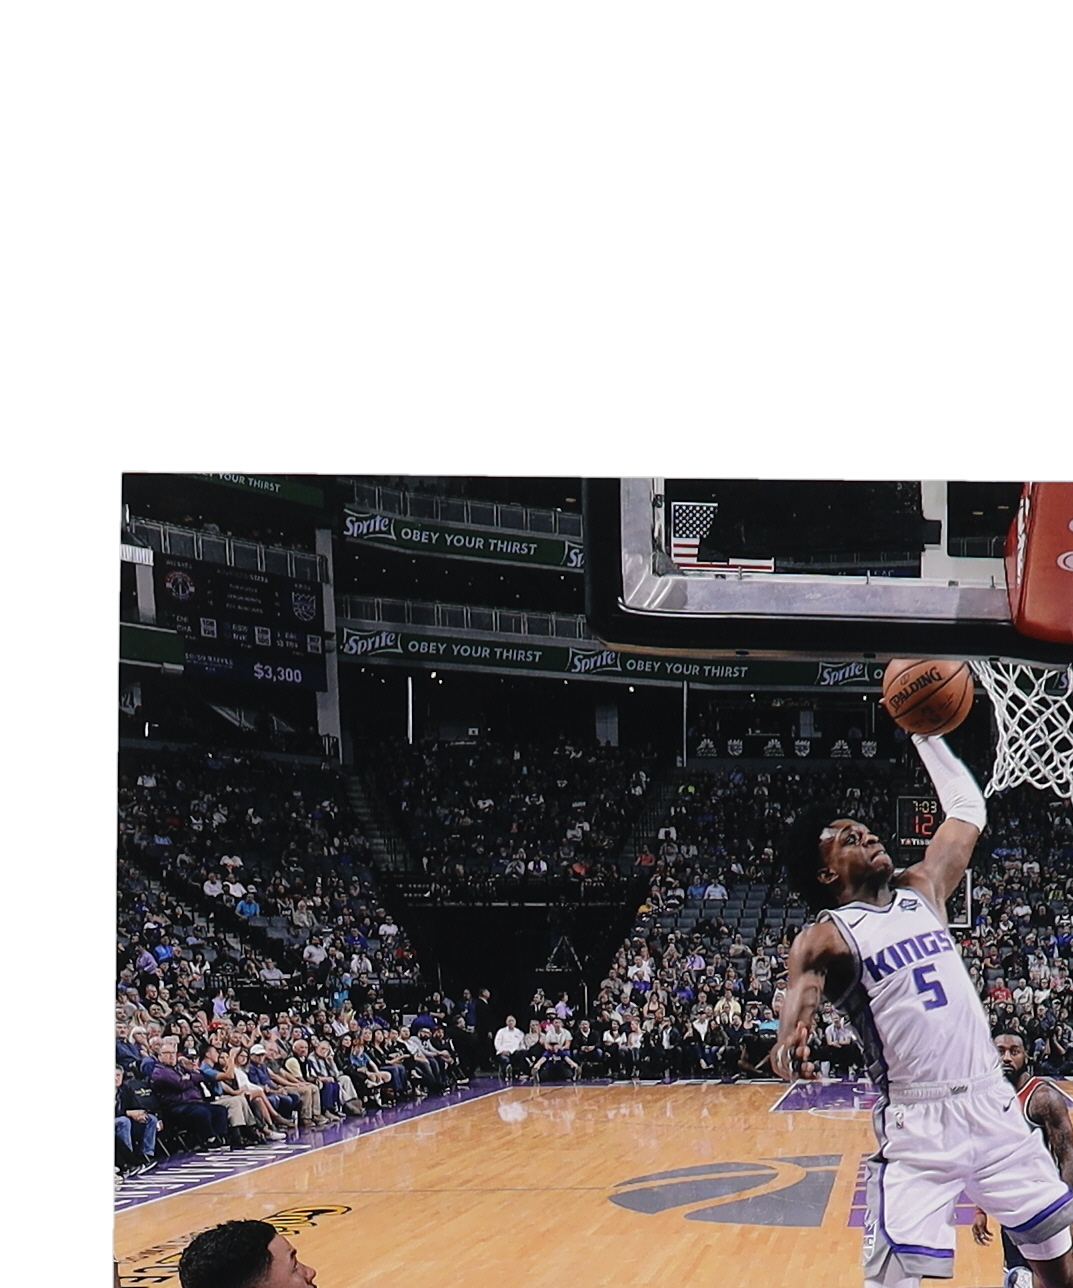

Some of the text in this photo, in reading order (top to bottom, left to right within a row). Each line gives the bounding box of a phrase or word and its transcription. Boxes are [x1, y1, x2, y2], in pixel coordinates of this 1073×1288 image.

[219, 473, 282, 493] YOUR THIRST
[343, 514, 538, 556] Sprite OBEY YOUR THIRST
[343, 630, 543, 662] Sprite OBEY YOUR THIRST
[253, 662, 303, 683] $3,300
[570, 650, 748, 678] Sprite OBEY YOUR THIRST
[820, 662, 864, 685] Sprite
[888, 666, 942, 713] SPALDING
[912, 800, 938, 814] 7:03
[914, 814, 934, 836] 12
[864, 930, 953, 983] KINGS
[912, 963, 948, 1012] 5
